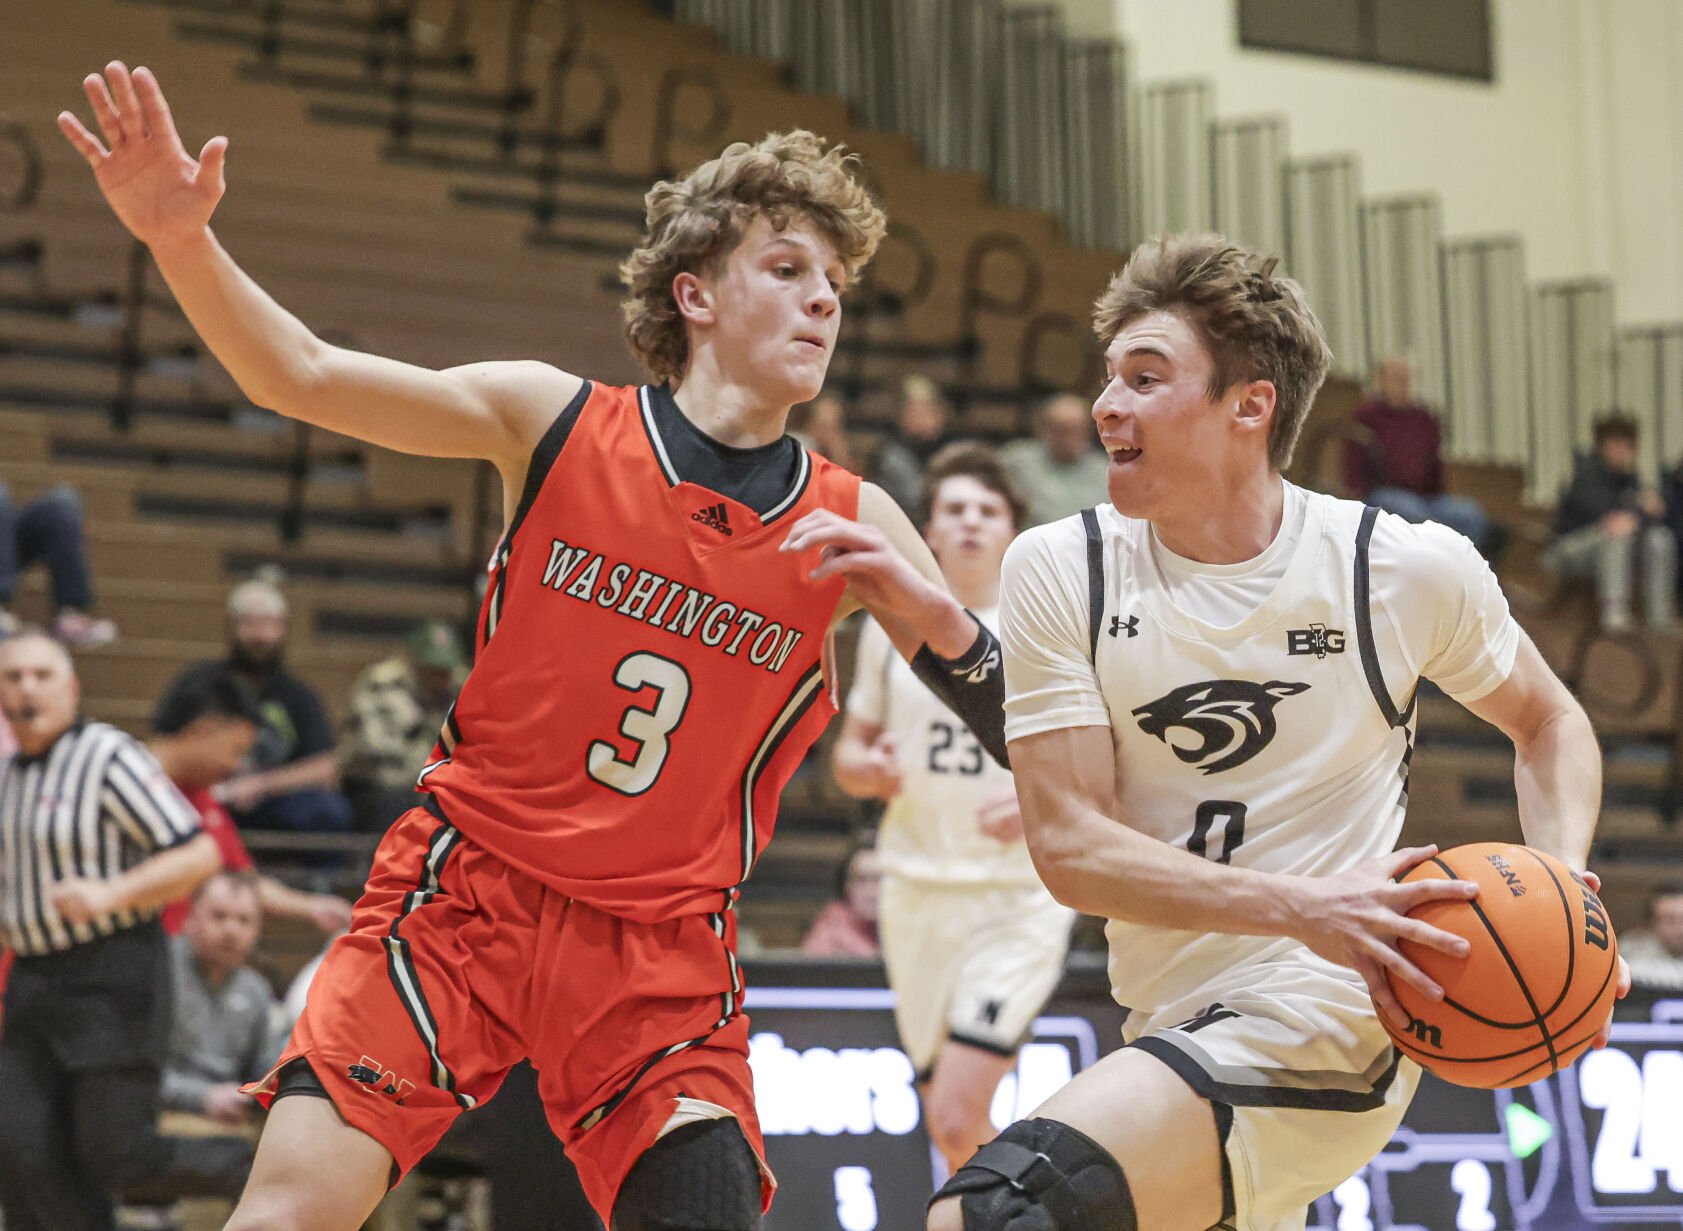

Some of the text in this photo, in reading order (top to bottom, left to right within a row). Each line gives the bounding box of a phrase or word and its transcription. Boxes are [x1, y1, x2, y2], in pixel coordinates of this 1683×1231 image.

[691, 513, 733, 536] adidas
[541, 538, 803, 673] WASHINGTON
[585, 650, 692, 797] 3
[929, 721, 984, 775] 23
